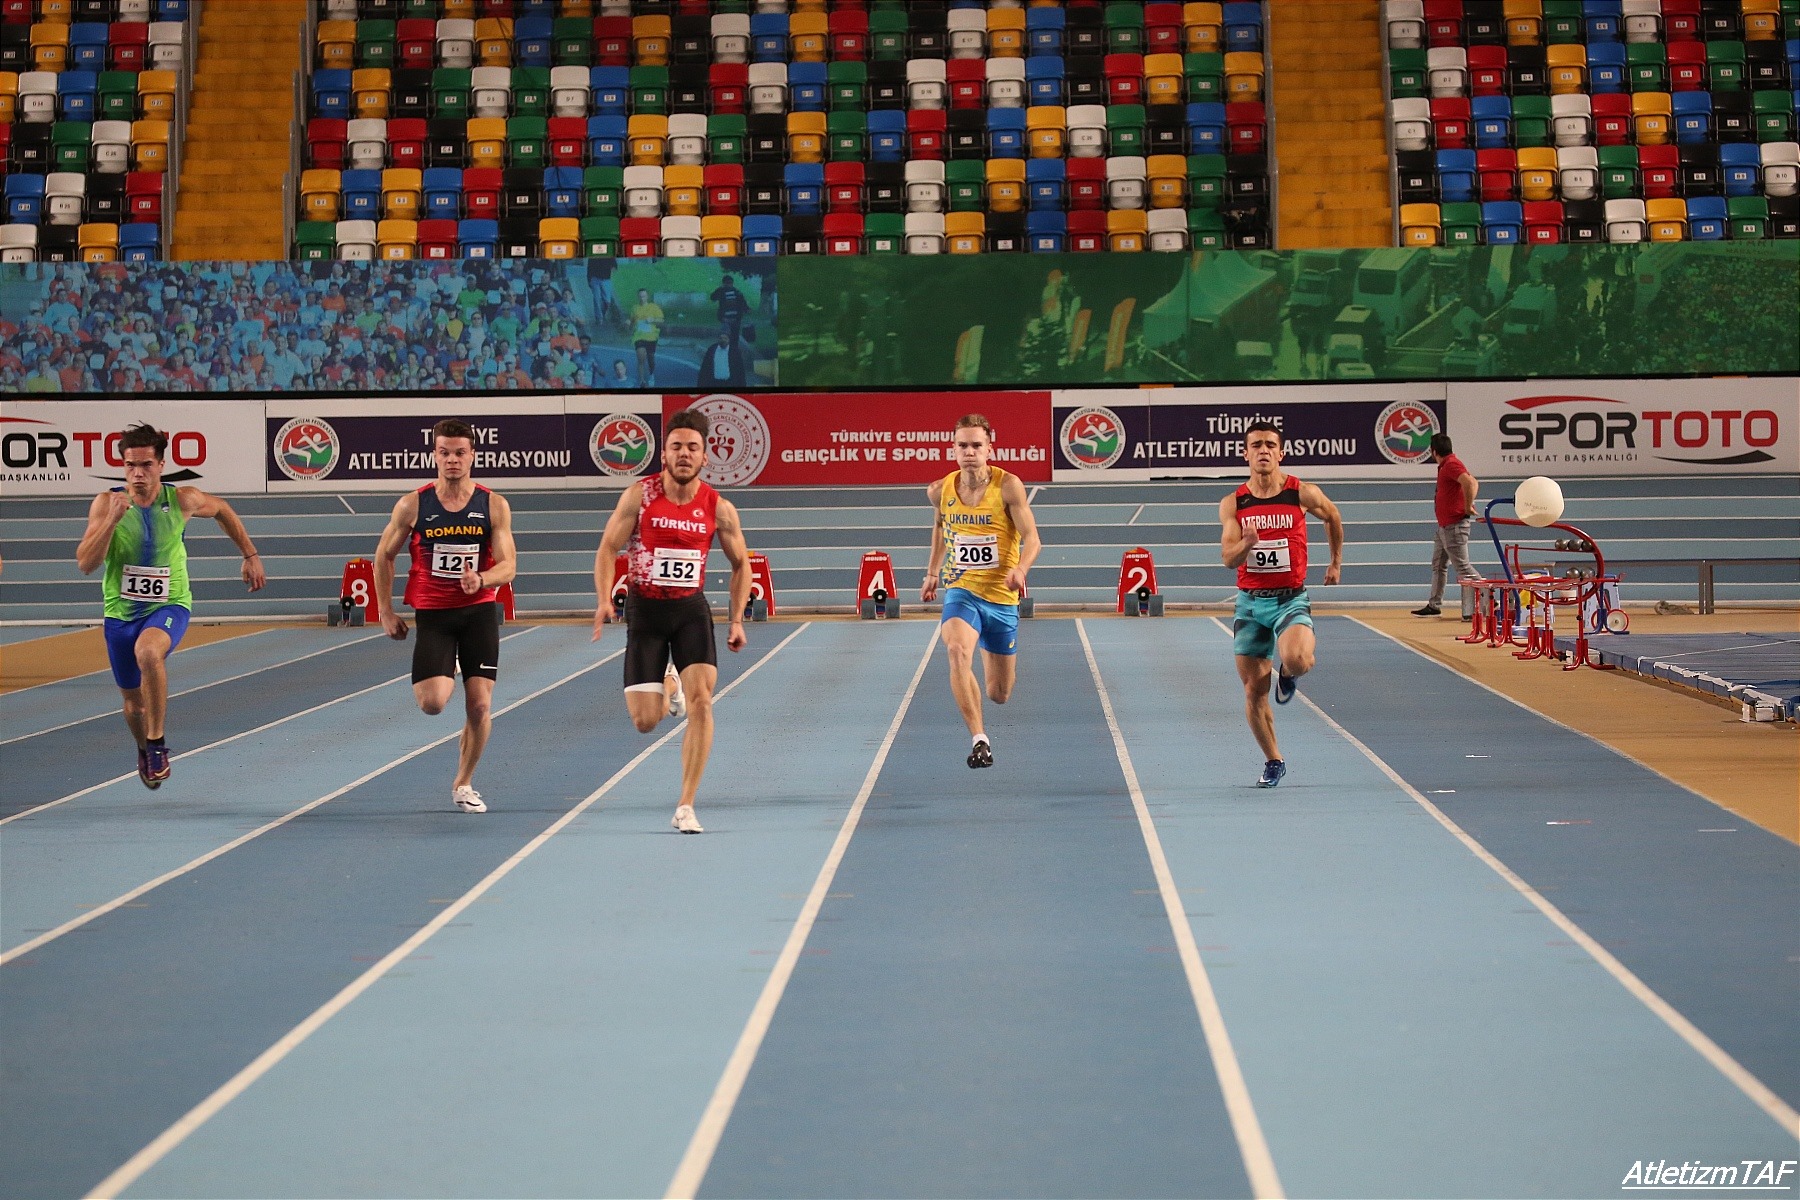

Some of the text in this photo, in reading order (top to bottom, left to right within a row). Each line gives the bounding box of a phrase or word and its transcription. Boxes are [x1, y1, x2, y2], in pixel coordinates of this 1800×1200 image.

[421, 424, 498, 445] TİYE
[830, 429, 996, 442] TÜRKİYE CUMHUİ
[781, 445, 1046, 465] GENÇLİK VE SPOR BANLIĞI
[1133, 437, 1356, 458] ATLETİZM FEASYONU
[348, 449, 571, 470] ATLETİZM ERASYONU
[1502, 452, 1638, 463] TEŞKİLAT BAŞKANLIĞI
[651, 516, 707, 534] TÜRKİYE
[949, 514, 992, 524] UKRAINE
[425, 526, 484, 538] ROMANIA
[960, 547, 993, 562] 208
[1256, 551, 1279, 566] 94
[438, 556, 473, 571] 125
[660, 561, 694, 578] 152
[127, 578, 163, 595] 136
[867, 570, 889, 596] 4
[1127, 566, 1148, 594] 2
[351, 579, 369, 607] 8
